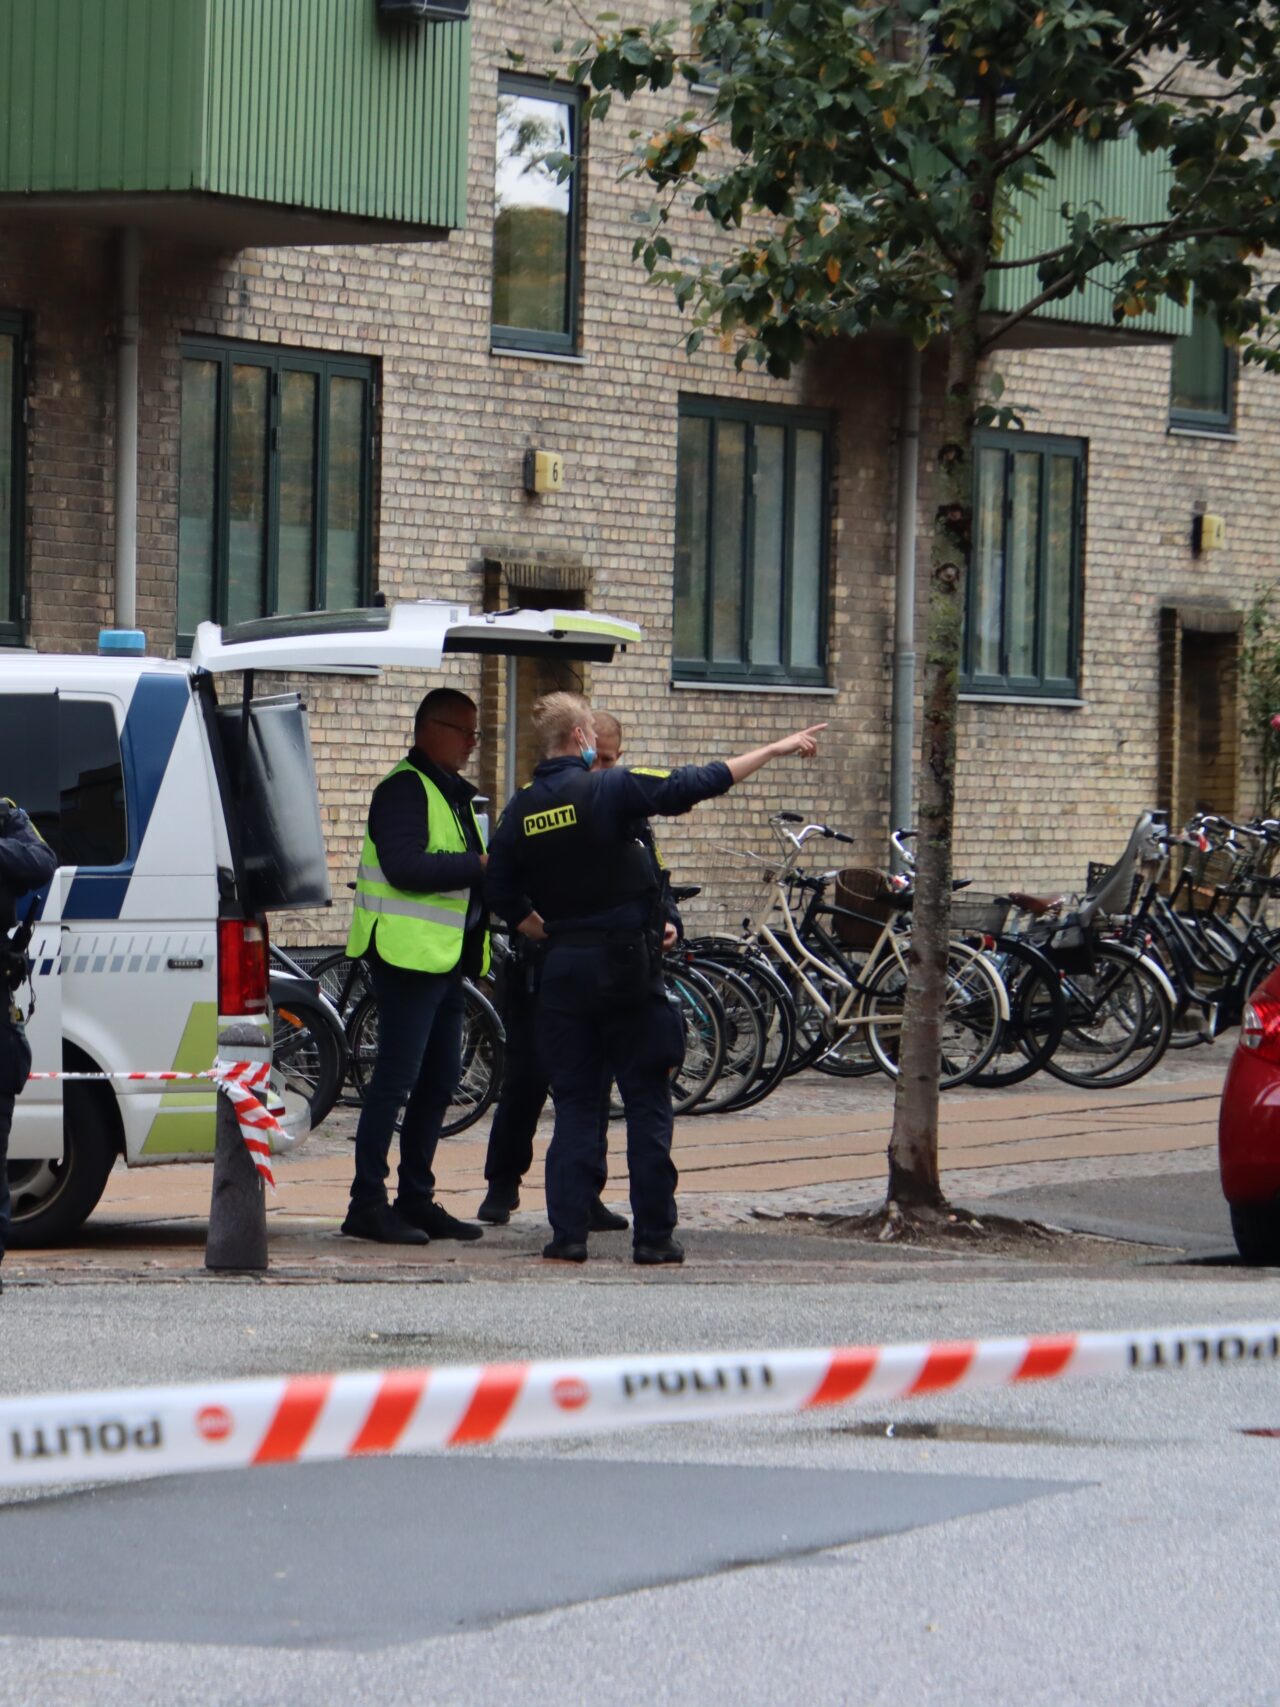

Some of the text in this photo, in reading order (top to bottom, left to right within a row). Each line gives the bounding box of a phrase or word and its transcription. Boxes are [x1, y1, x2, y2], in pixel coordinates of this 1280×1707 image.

[552, 461, 559, 483] 6
[525, 808, 575, 834] POLITI
[622, 1363, 774, 1398] POLITI
[11, 1417, 164, 1459] POLITI
